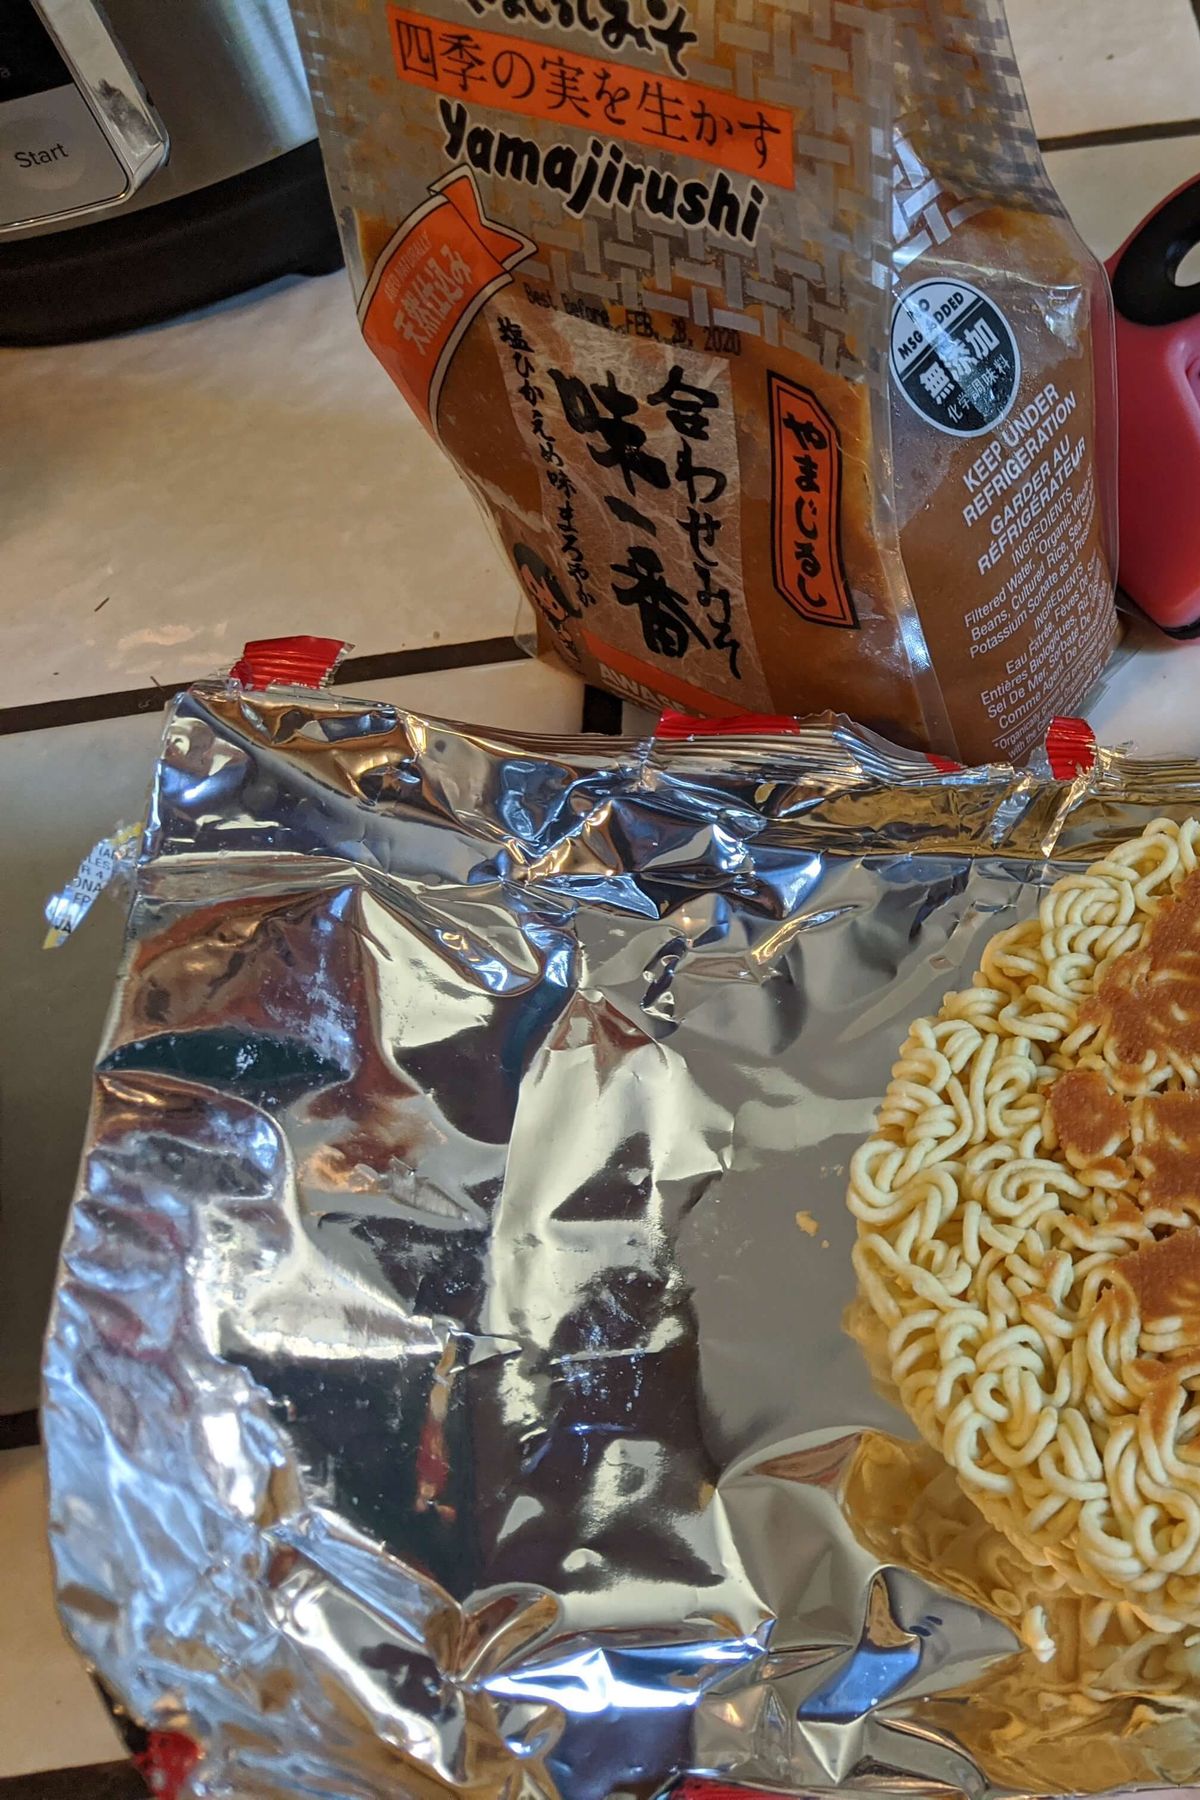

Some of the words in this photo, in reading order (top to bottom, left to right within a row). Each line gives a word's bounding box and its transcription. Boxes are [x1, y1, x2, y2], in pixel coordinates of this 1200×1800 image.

[395, 19, 782, 169] 四季の実を生かす
[14, 143, 69, 168] Start
[439, 99, 765, 240] Yamajirushi
[897, 330, 924, 360] MSG
[929, 291, 964, 332] DDED
[962, 440, 1003, 494] KEEP
[1001, 383, 1060, 449] UNDER
[962, 391, 1077, 527] REFRIGERATION
[546, 367, 713, 659] 味一番
[977, 436, 1086, 575] RÉFRIGÉRATEUR
[990, 461, 1051, 536] GARDER
[1053, 434, 1071, 468] AU
[964, 588, 1006, 628] Filtered
[969, 610, 1028, 659] Potassium
[1027, 572, 1059, 614] Sorbate
[1060, 560, 1069, 577] as
[971, 611, 1011, 641] Beans,
[1011, 560, 1045, 610] Cultured
[1005, 654, 1028, 675] Eau
[1054, 590, 1080, 622] Fèves
[980, 669, 1028, 706] Entières
[987, 697, 1007, 718] Sel
[1008, 687, 1026, 705] De
[999, 690, 1042, 730] Comme
[1042, 659, 1065, 695] Agent
[1065, 646, 1077, 664] De
